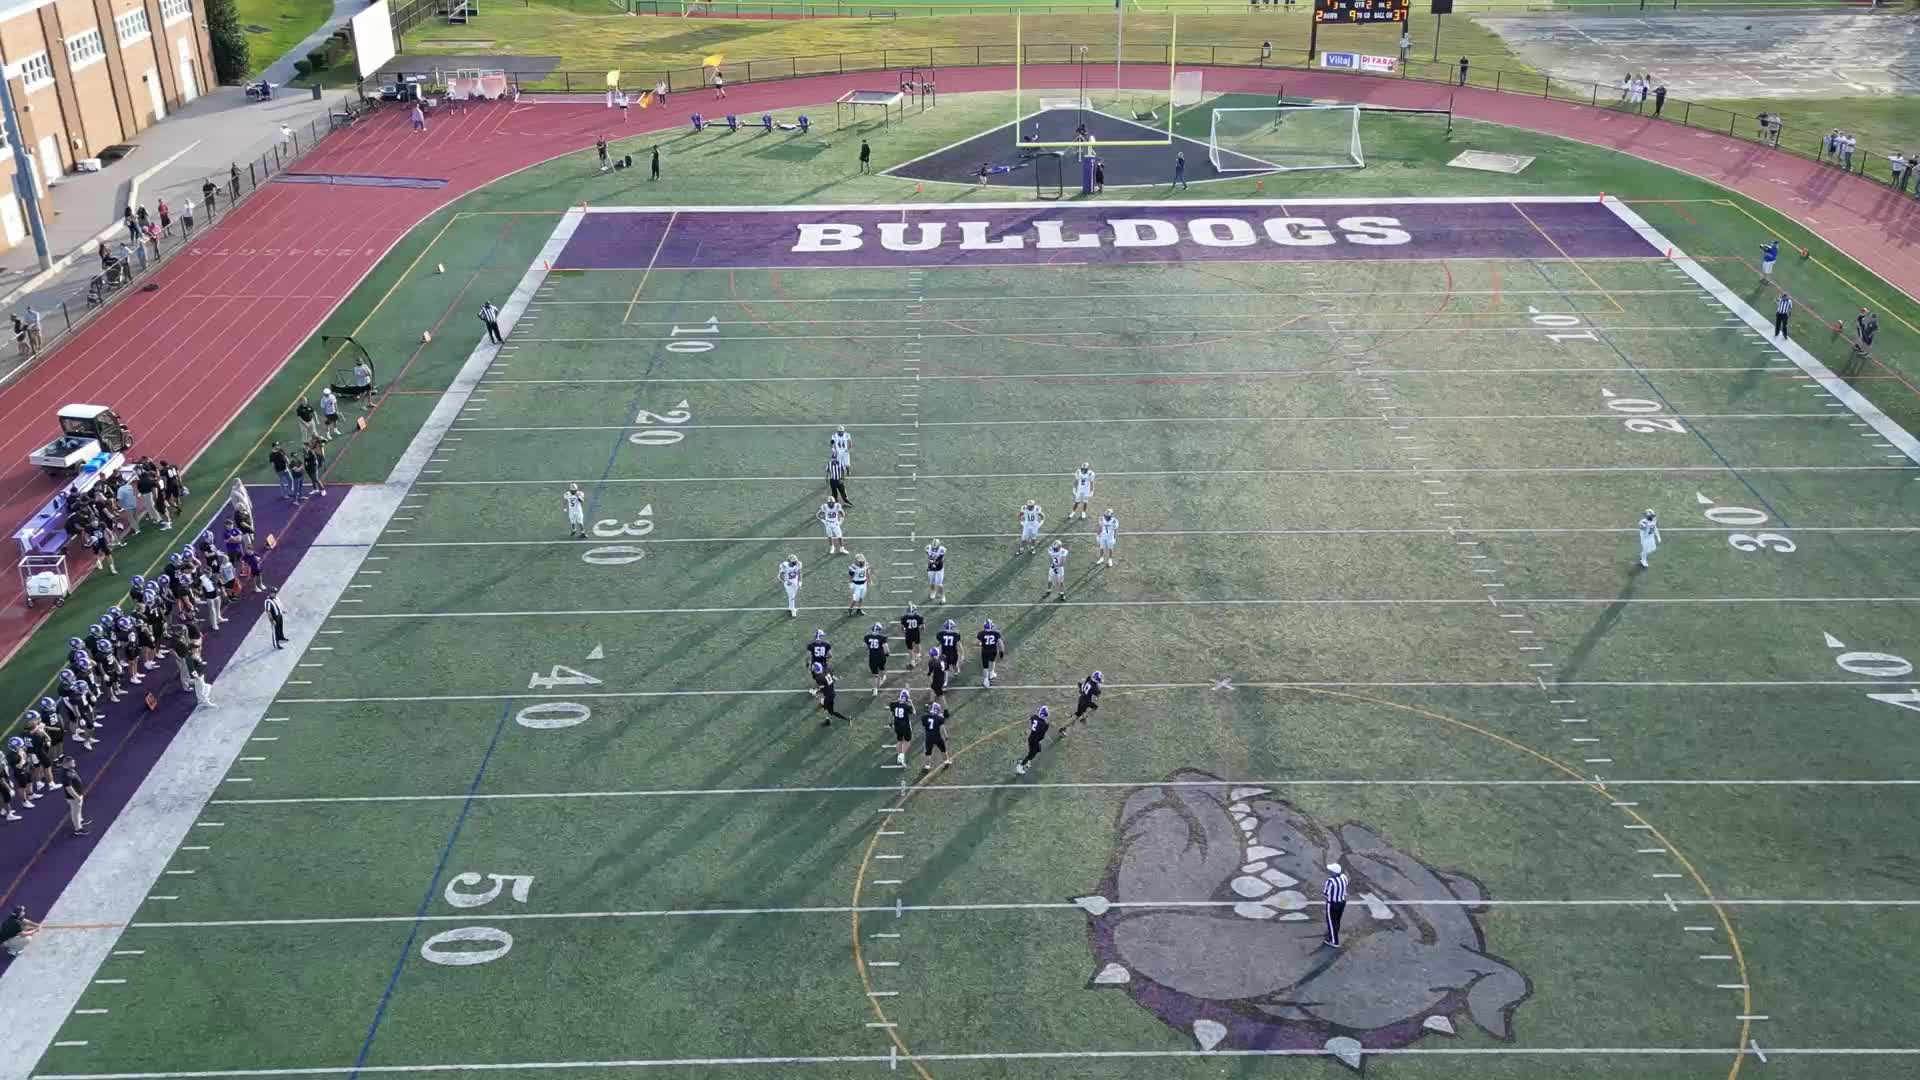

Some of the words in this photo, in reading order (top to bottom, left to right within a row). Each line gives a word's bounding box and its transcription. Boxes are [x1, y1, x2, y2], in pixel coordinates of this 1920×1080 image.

[1316, 10, 1323, 22] 2
[1349, 10, 1356, 22] 9
[1393, 9, 1407, 21] 37
[792, 216, 1412, 252] BULLDOGS
[666, 325, 720, 352] 10
[1532, 314, 1599, 343] 10
[629, 410, 691, 444] 20
[1607, 399, 1687, 433] 20
[582, 519, 654, 565] 30
[1704, 506, 1797, 553] 30
[906, 619, 918, 629] 70
[814, 646, 826, 657] 58
[943, 635, 954, 646] 77
[983, 634, 997, 645] 72
[516, 665, 602, 728] 40
[894, 707, 905, 719] 18
[420, 872, 535, 965] 50
